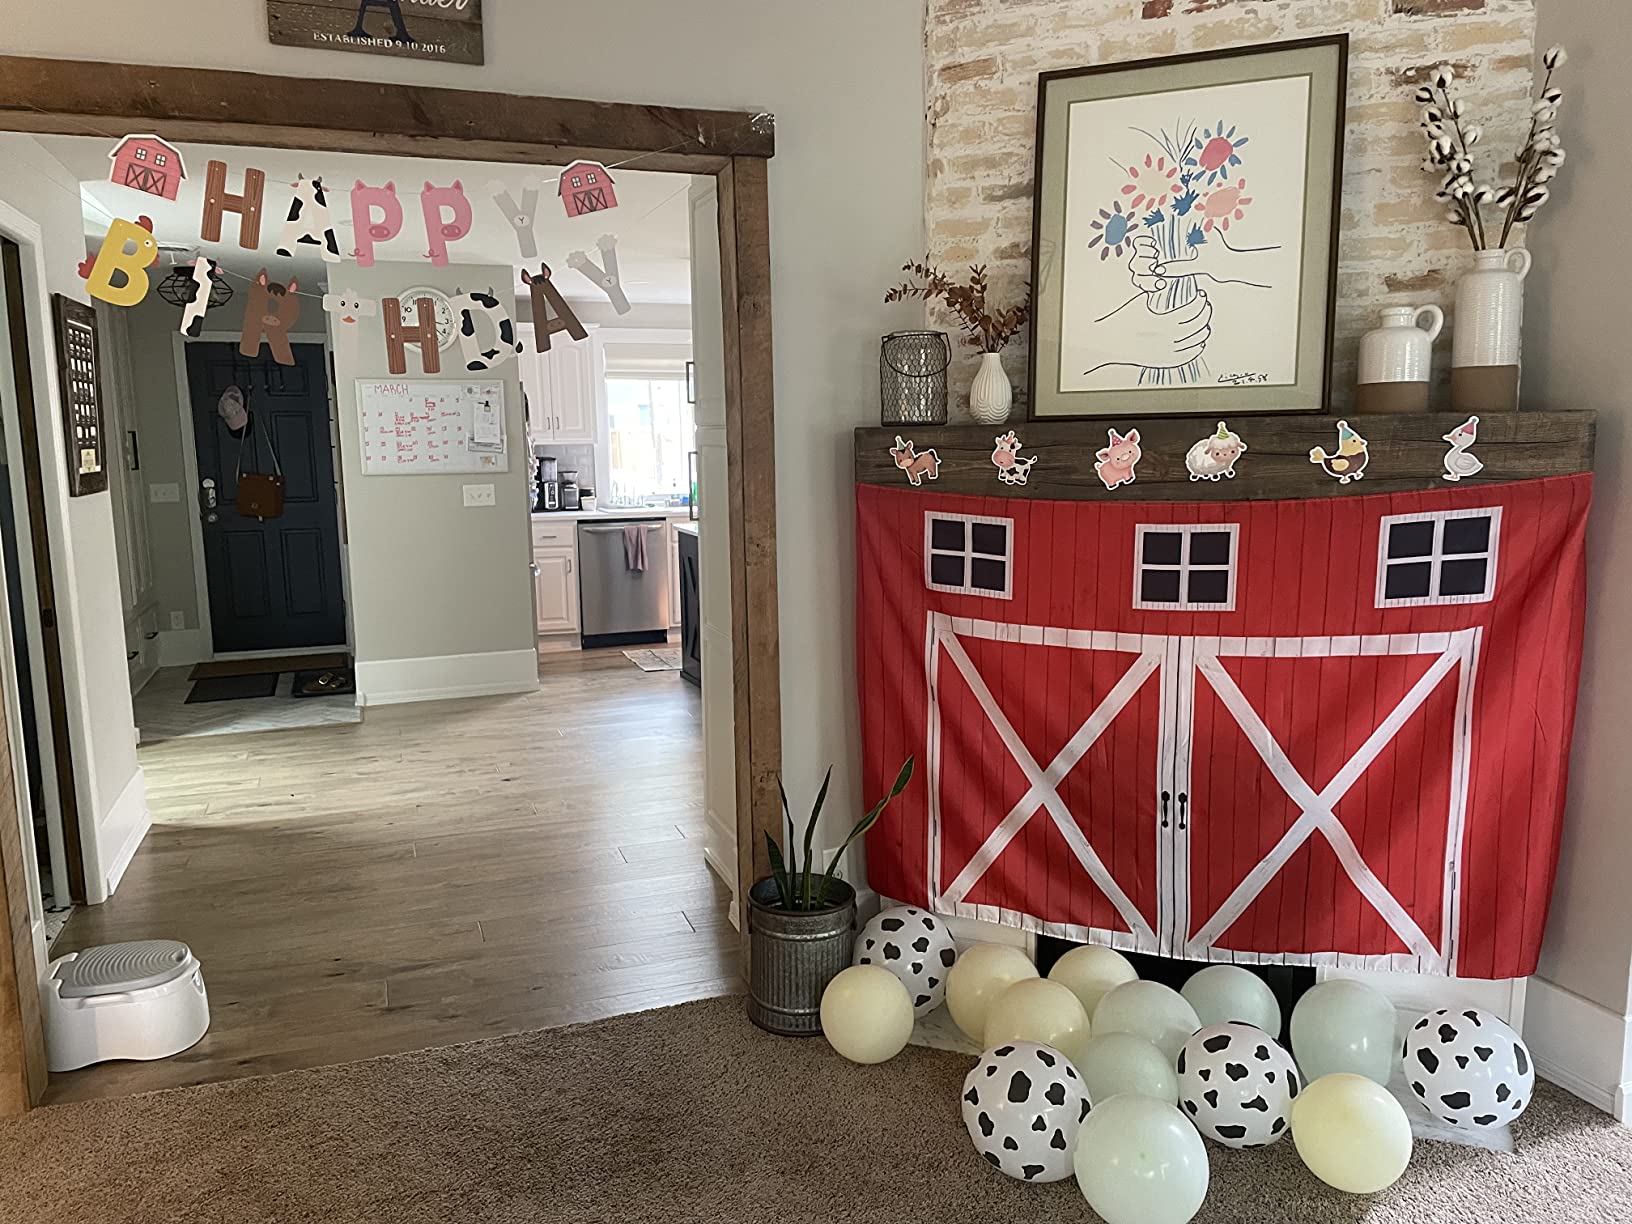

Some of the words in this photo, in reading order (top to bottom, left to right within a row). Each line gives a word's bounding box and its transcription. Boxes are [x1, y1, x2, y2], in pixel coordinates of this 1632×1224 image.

[313, 32, 393, 48] ESTABLISHED
[201, 160, 541, 267] HAPPY
[79, 215, 632, 374] BIRTHDAY
[401, 315, 406, 323] 9
[374, 384, 409, 395] MARCH
